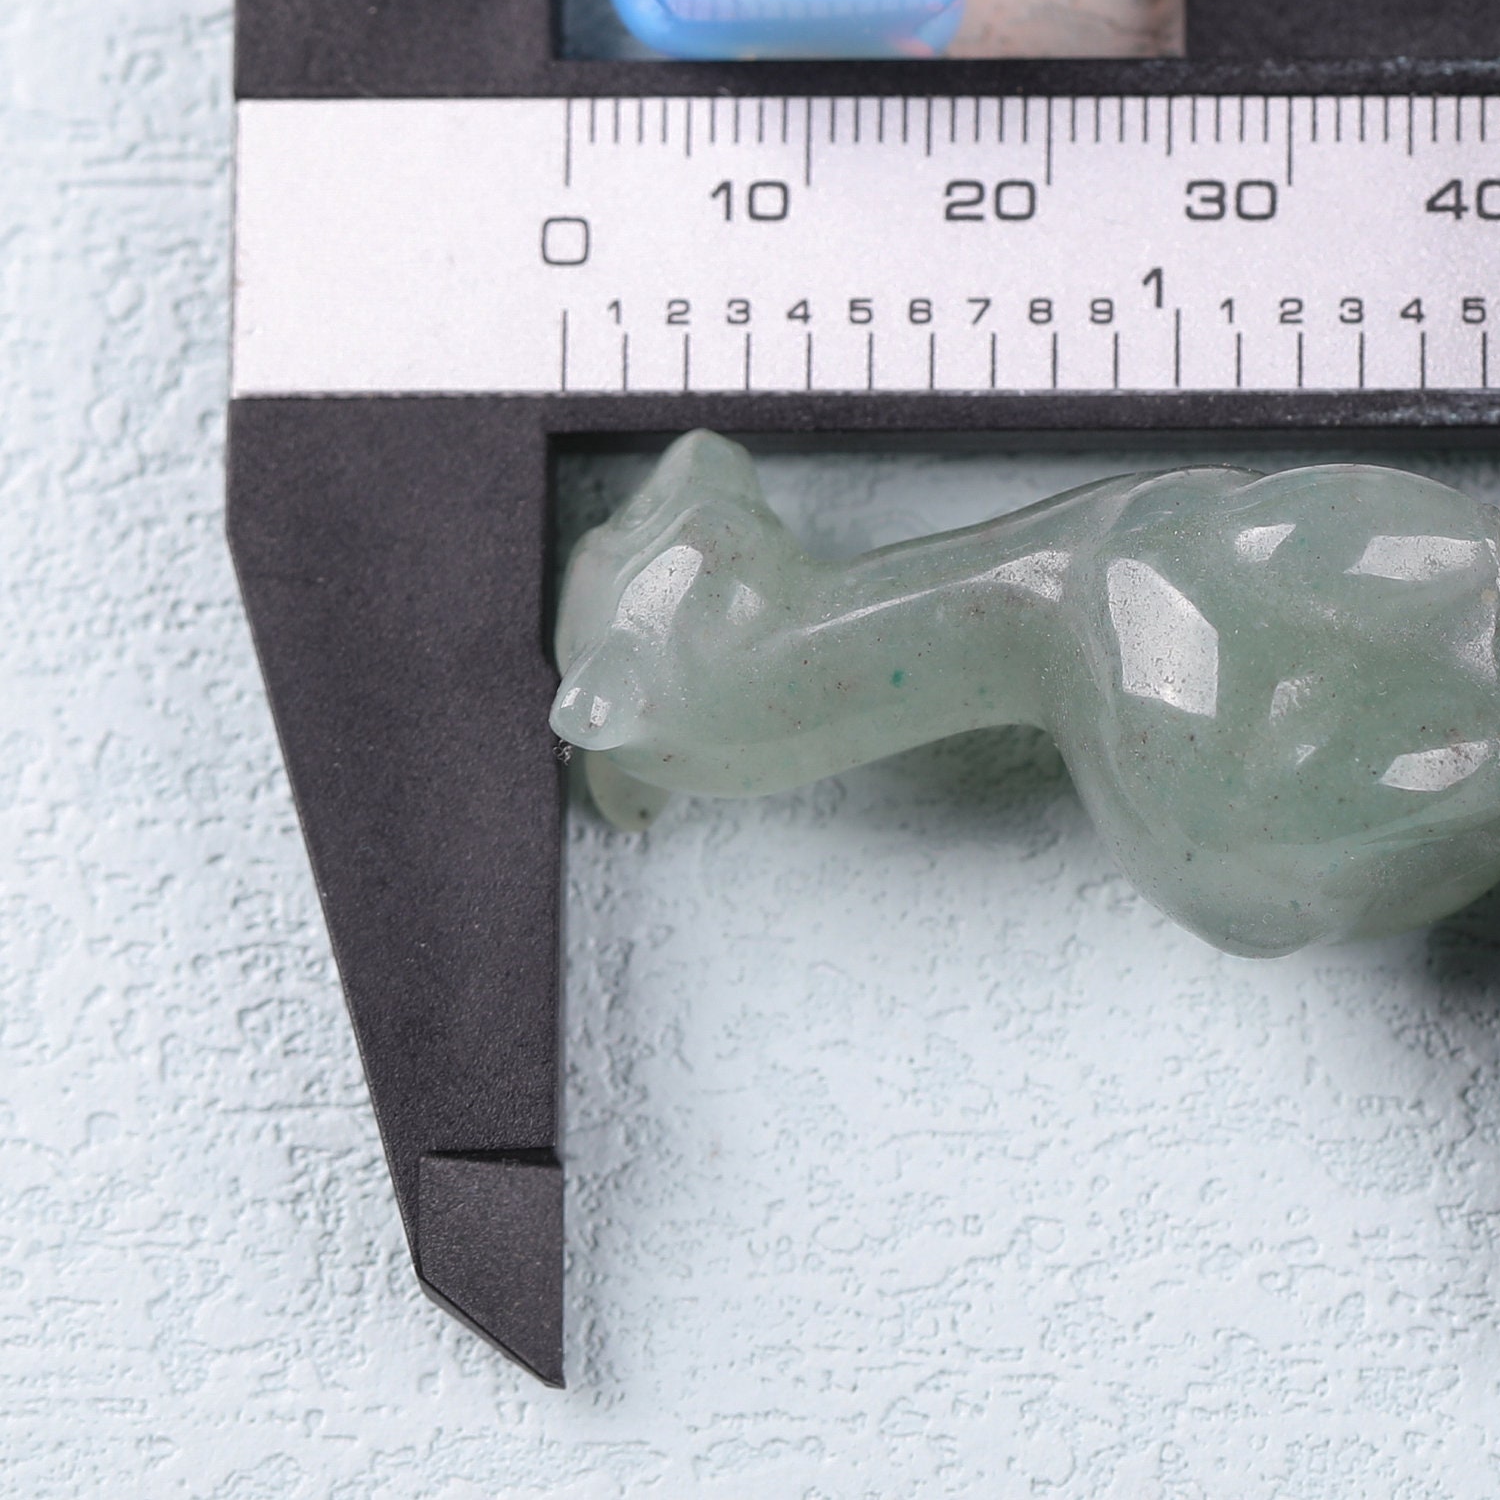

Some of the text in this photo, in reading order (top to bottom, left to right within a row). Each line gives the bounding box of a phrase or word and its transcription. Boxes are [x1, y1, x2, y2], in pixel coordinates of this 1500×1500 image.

[711, 180, 790, 222] 10
[944, 179, 1037, 222] 20
[1184, 179, 1278, 222] 30
[541, 216, 590, 267] 0
[609, 267, 1487, 326] 1 2 3 4 5 6 7 8 9 1 1 2 3 4 5
